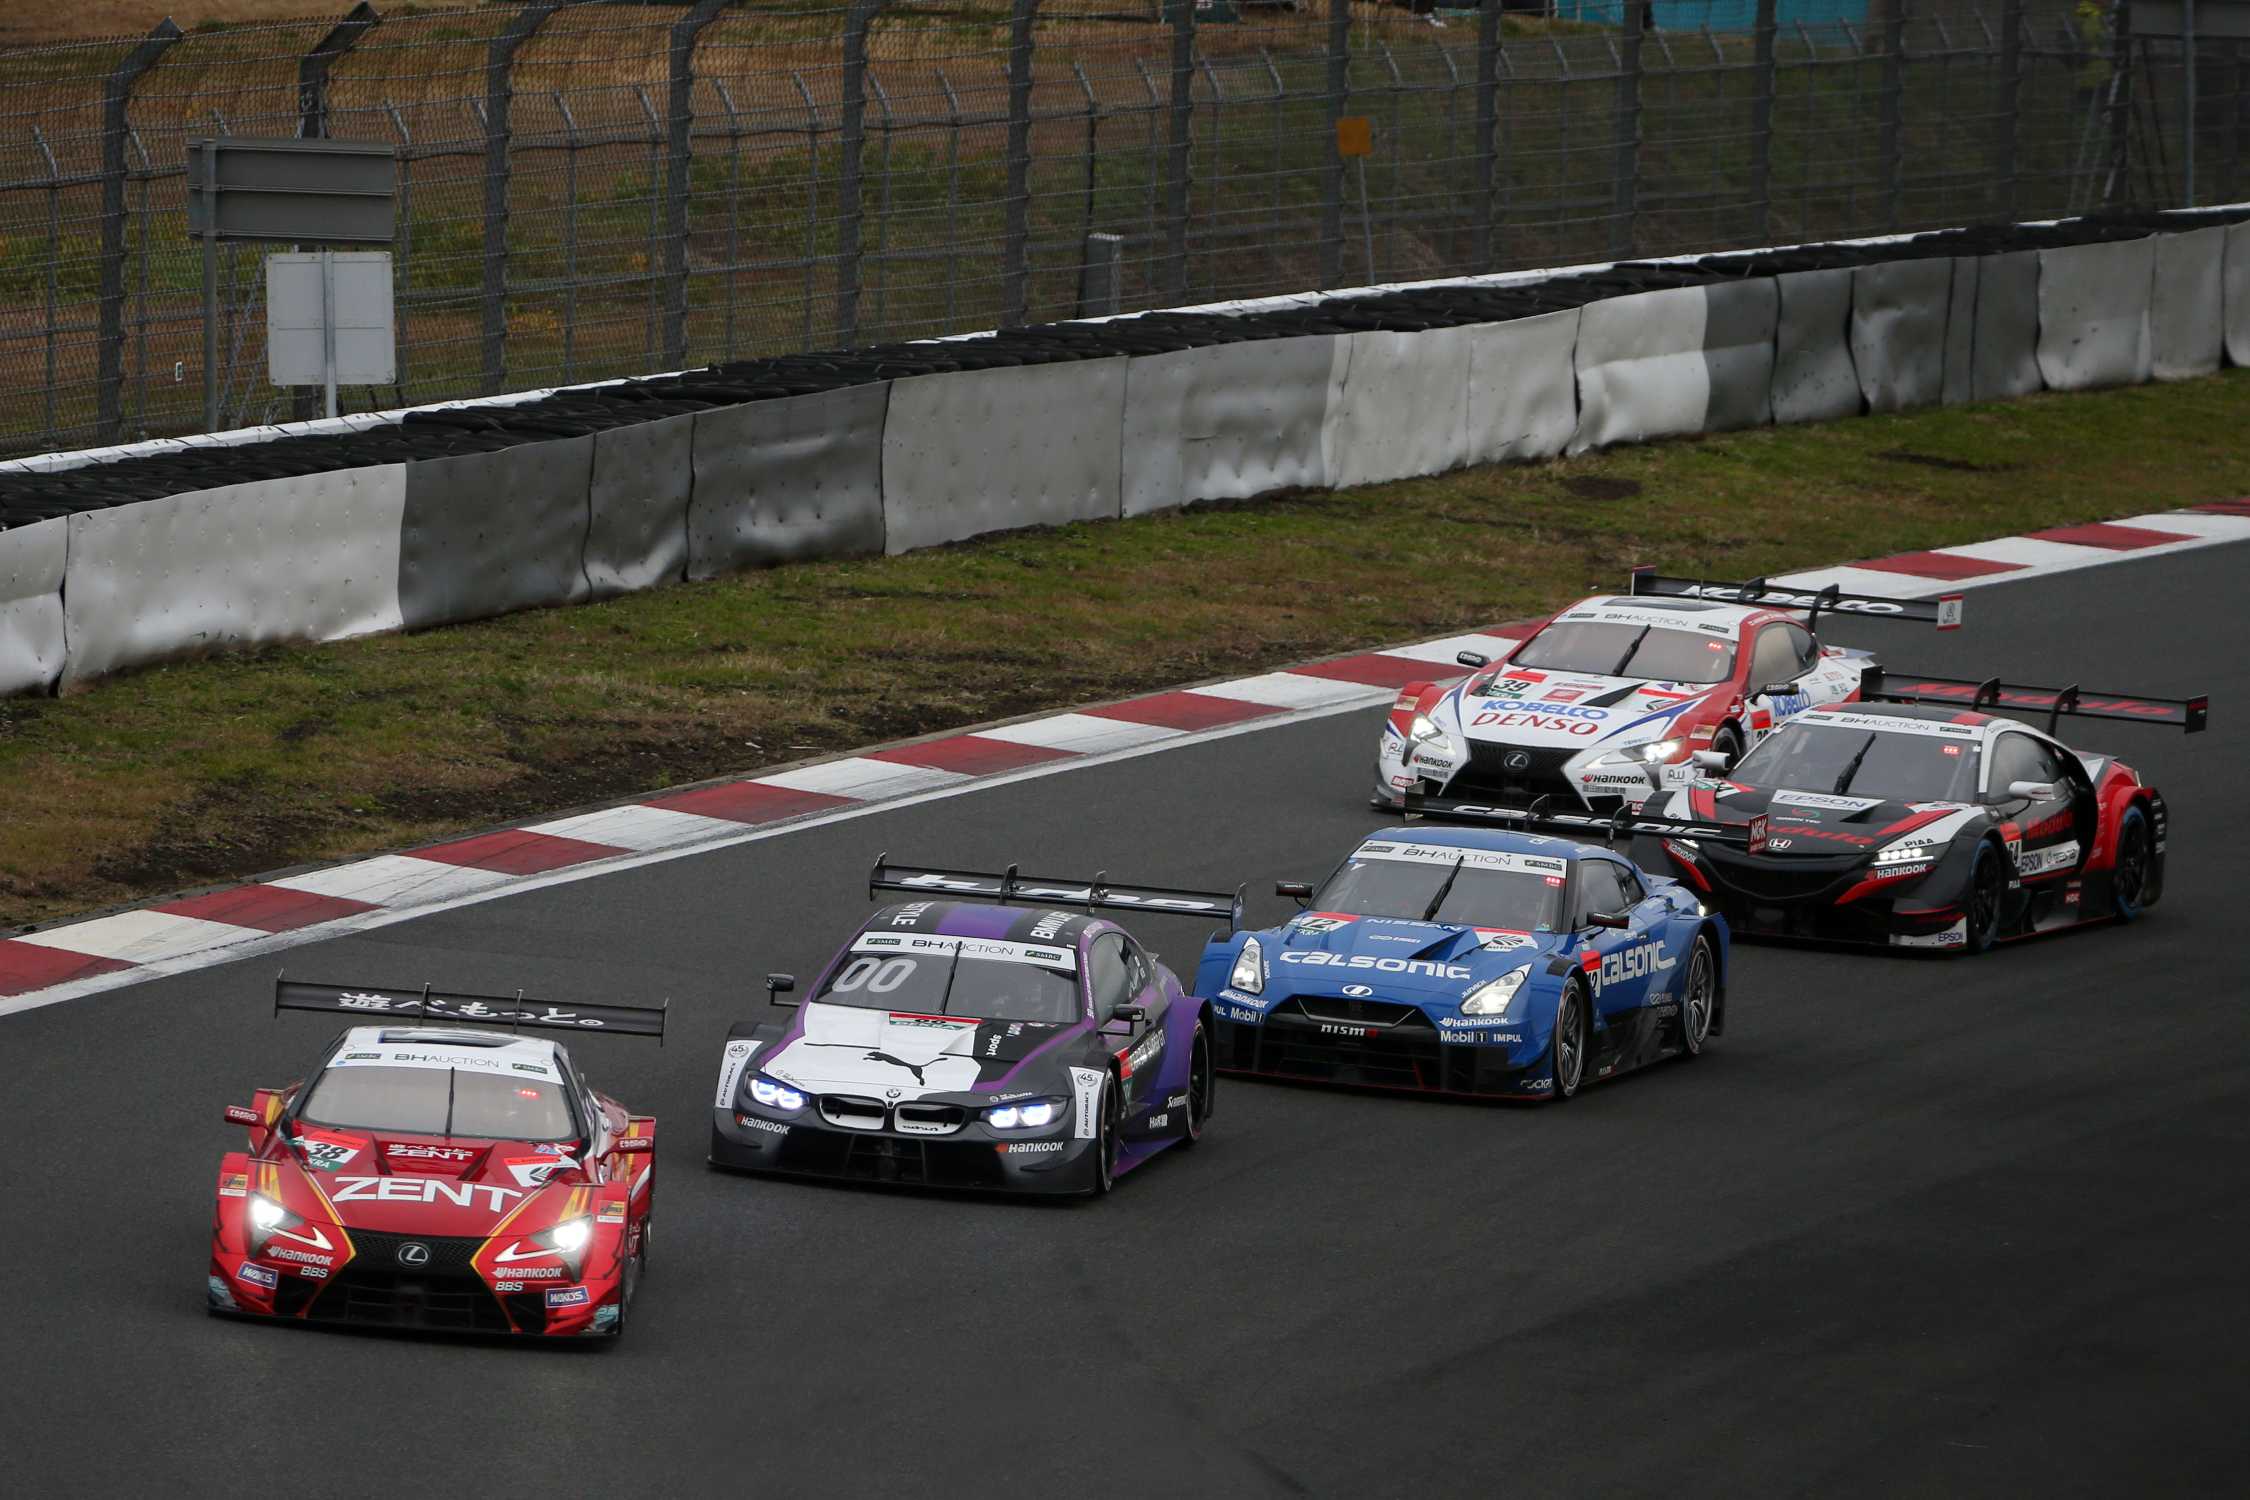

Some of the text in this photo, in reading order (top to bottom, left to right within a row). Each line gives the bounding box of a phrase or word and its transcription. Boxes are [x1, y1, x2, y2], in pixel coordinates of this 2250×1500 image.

[1492, 679, 1532, 692] 39
[1480, 699, 1610, 720] KOBELCO
[1471, 711, 1600, 736] DENSO
[1779, 793, 1867, 808] EPSON
[1750, 818, 1768, 841] NGK
[1904, 838, 1935, 847] PIAA
[1366, 918, 1463, 931] NISSAN
[831, 957, 918, 993] 00
[1230, 1007, 1257, 1022] Mobil
[1440, 1030, 1474, 1043] Mobil
[1493, 1033, 1523, 1042] IMPUL
[985, 1033, 1003, 1056] sport
[309, 1143, 349, 1159] 38
[386, 1148, 474, 1160] ZENT
[332, 1175, 523, 1214] ZENT
[300, 1266, 329, 1278] BBS
[495, 1281, 525, 1292] BBS
